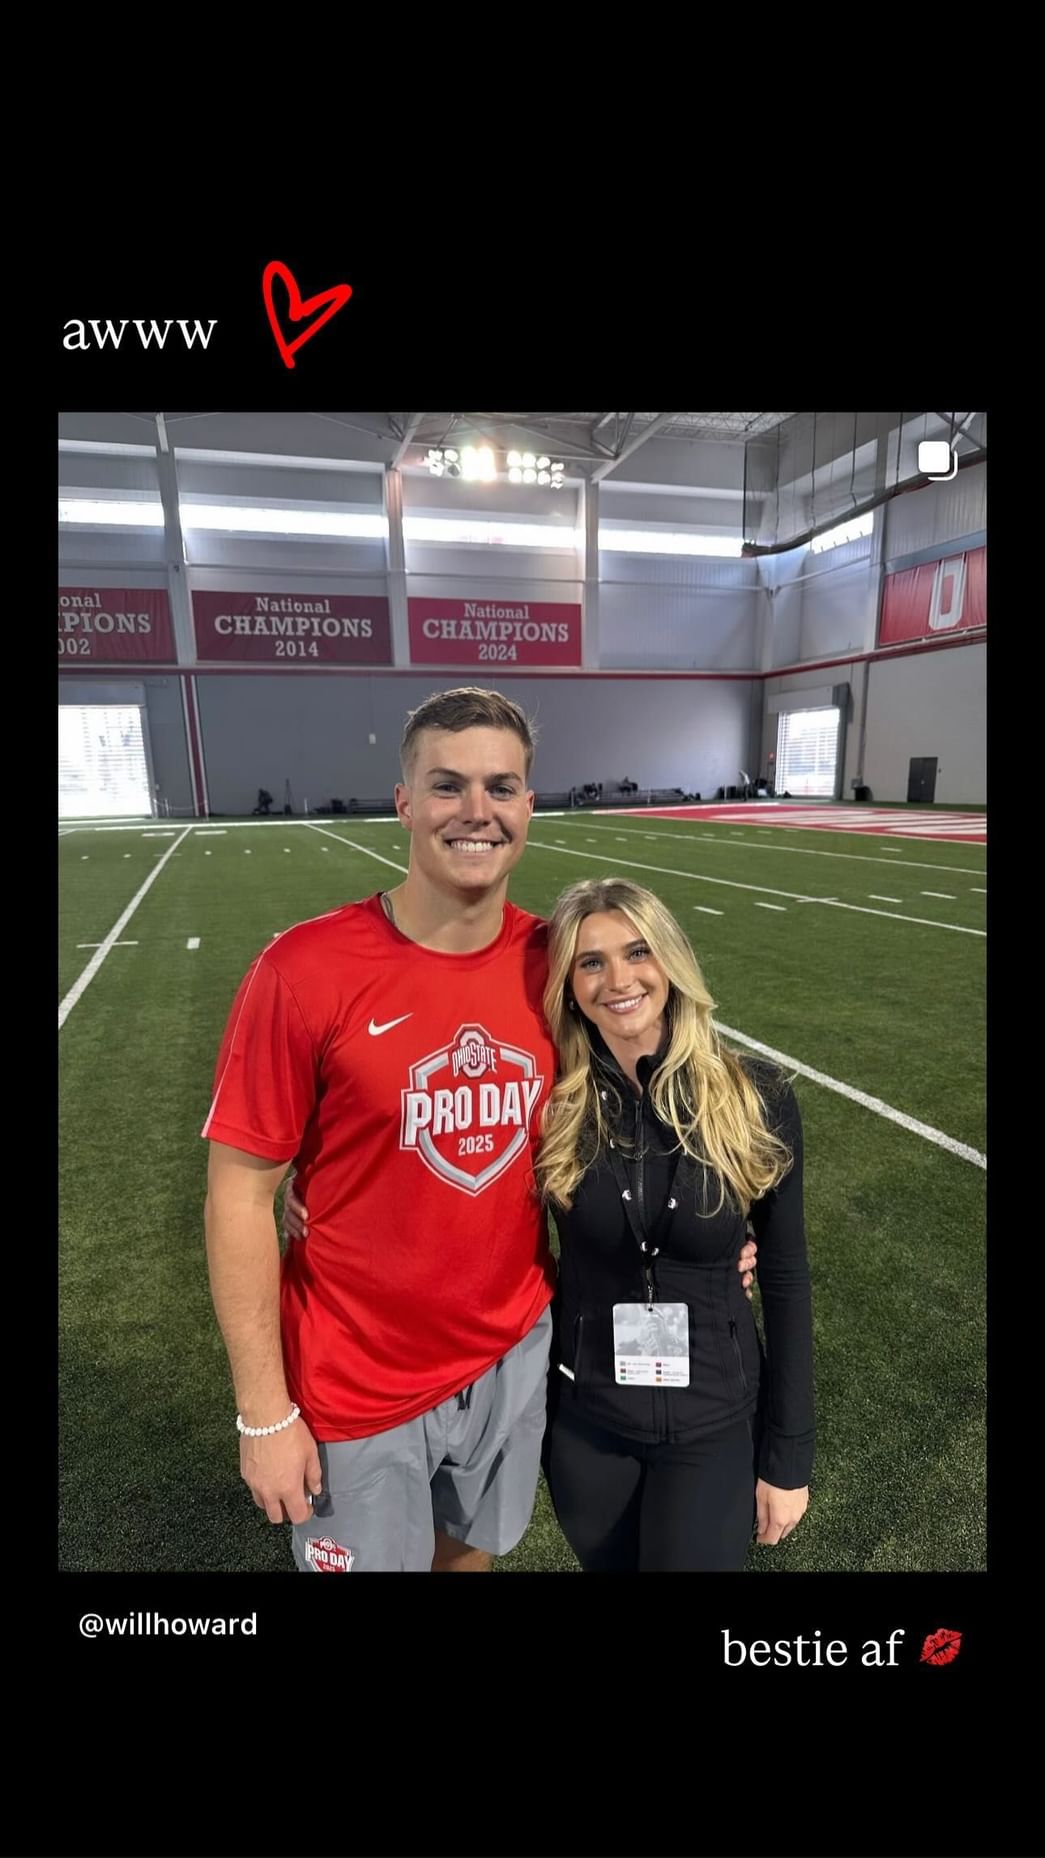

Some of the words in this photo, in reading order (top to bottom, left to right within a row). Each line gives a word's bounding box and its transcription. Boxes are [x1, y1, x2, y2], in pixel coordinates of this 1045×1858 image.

[255, 597, 331, 614] National
[464, 603, 530, 620] National
[58, 612, 152, 633] PIONS
[214, 615, 373, 638] CHAMPIONS
[422, 619, 569, 642] CHAMPIONS
[275, 640, 319, 657] 2014
[478, 643, 518, 661] 2024
[404, 1085, 473, 1146] PRO
[479, 1079, 542, 1132] DAY
[458, 1133, 495, 1157] 2025
[307, 1543, 329, 1564] PRO
[329, 1551, 353, 1572] DAY
